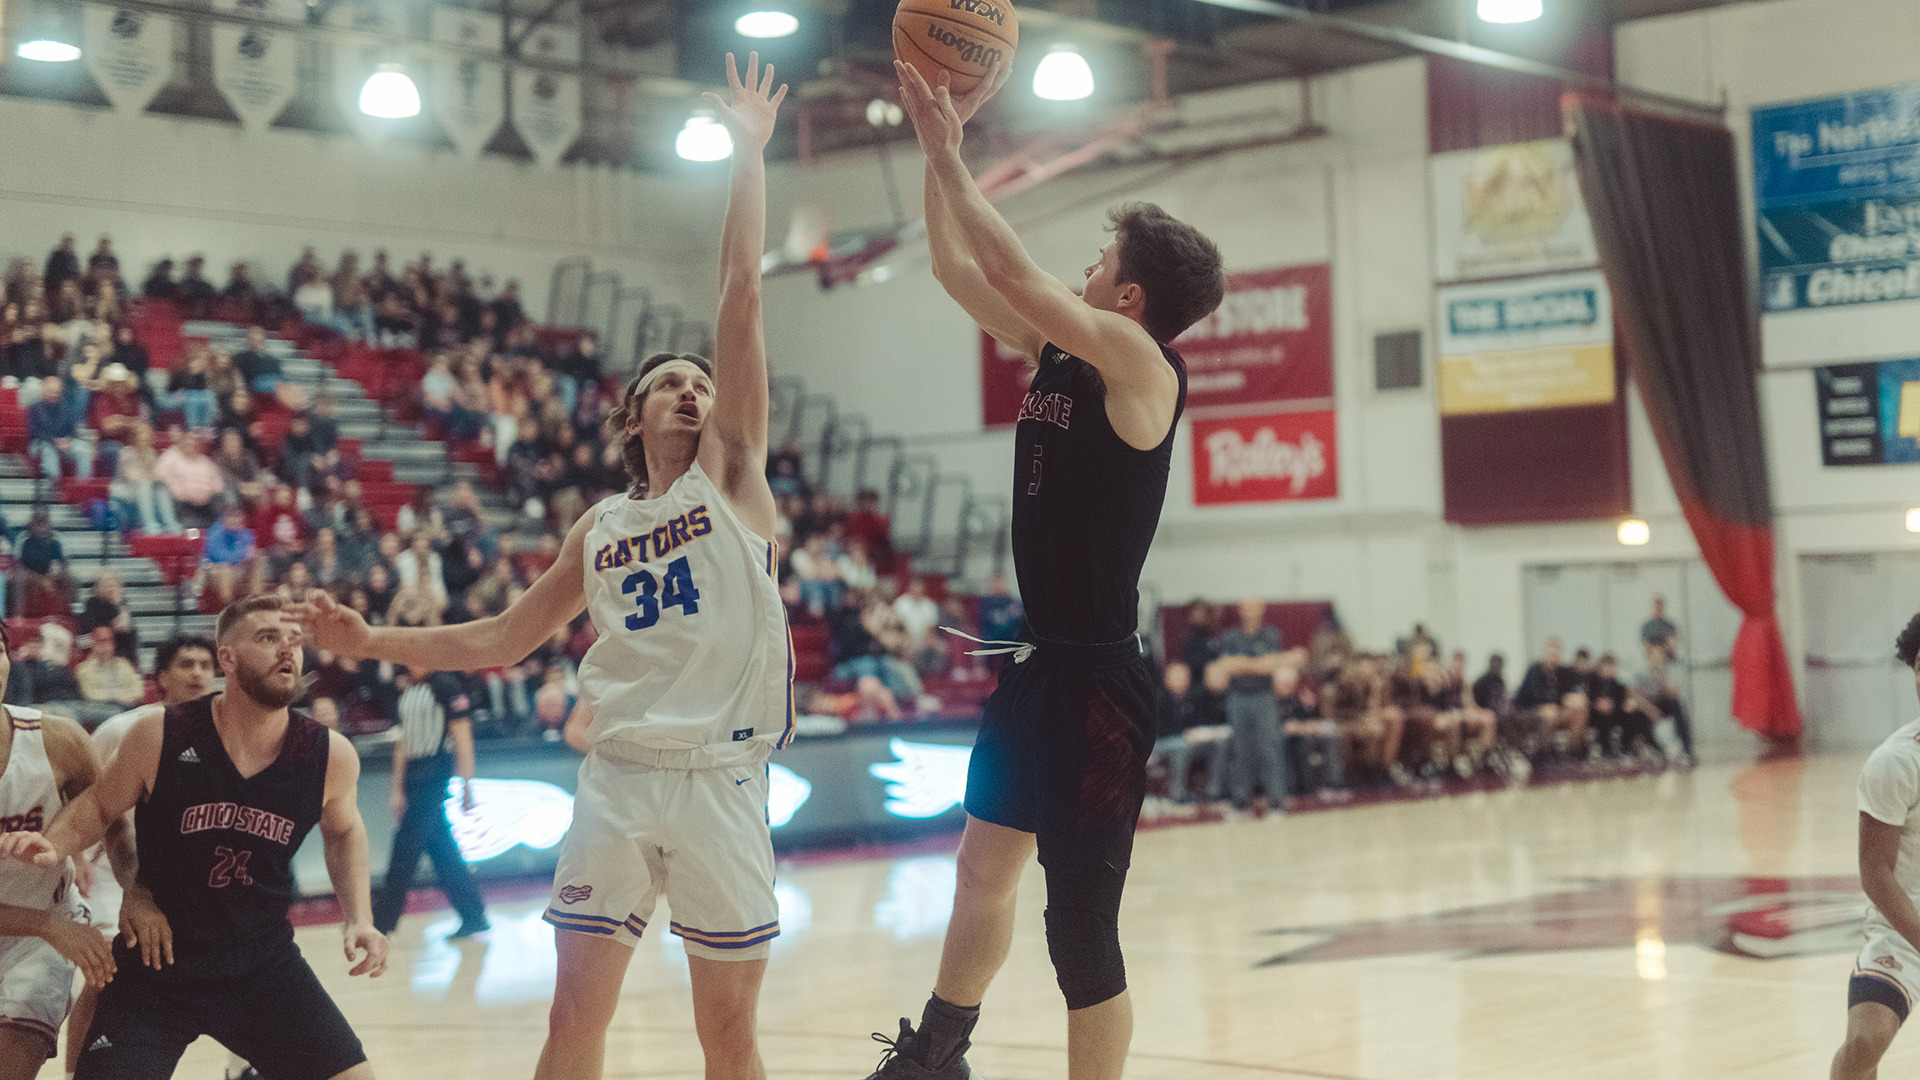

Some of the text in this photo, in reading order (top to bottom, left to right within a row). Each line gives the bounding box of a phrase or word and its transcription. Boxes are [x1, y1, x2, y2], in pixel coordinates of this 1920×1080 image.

[927, 22, 1002, 68] Wilson
[595, 503, 714, 572] GATORS
[621, 555, 700, 631] 34
[180, 802, 295, 845] CHICO STATE
[208, 845, 254, 888] 24
